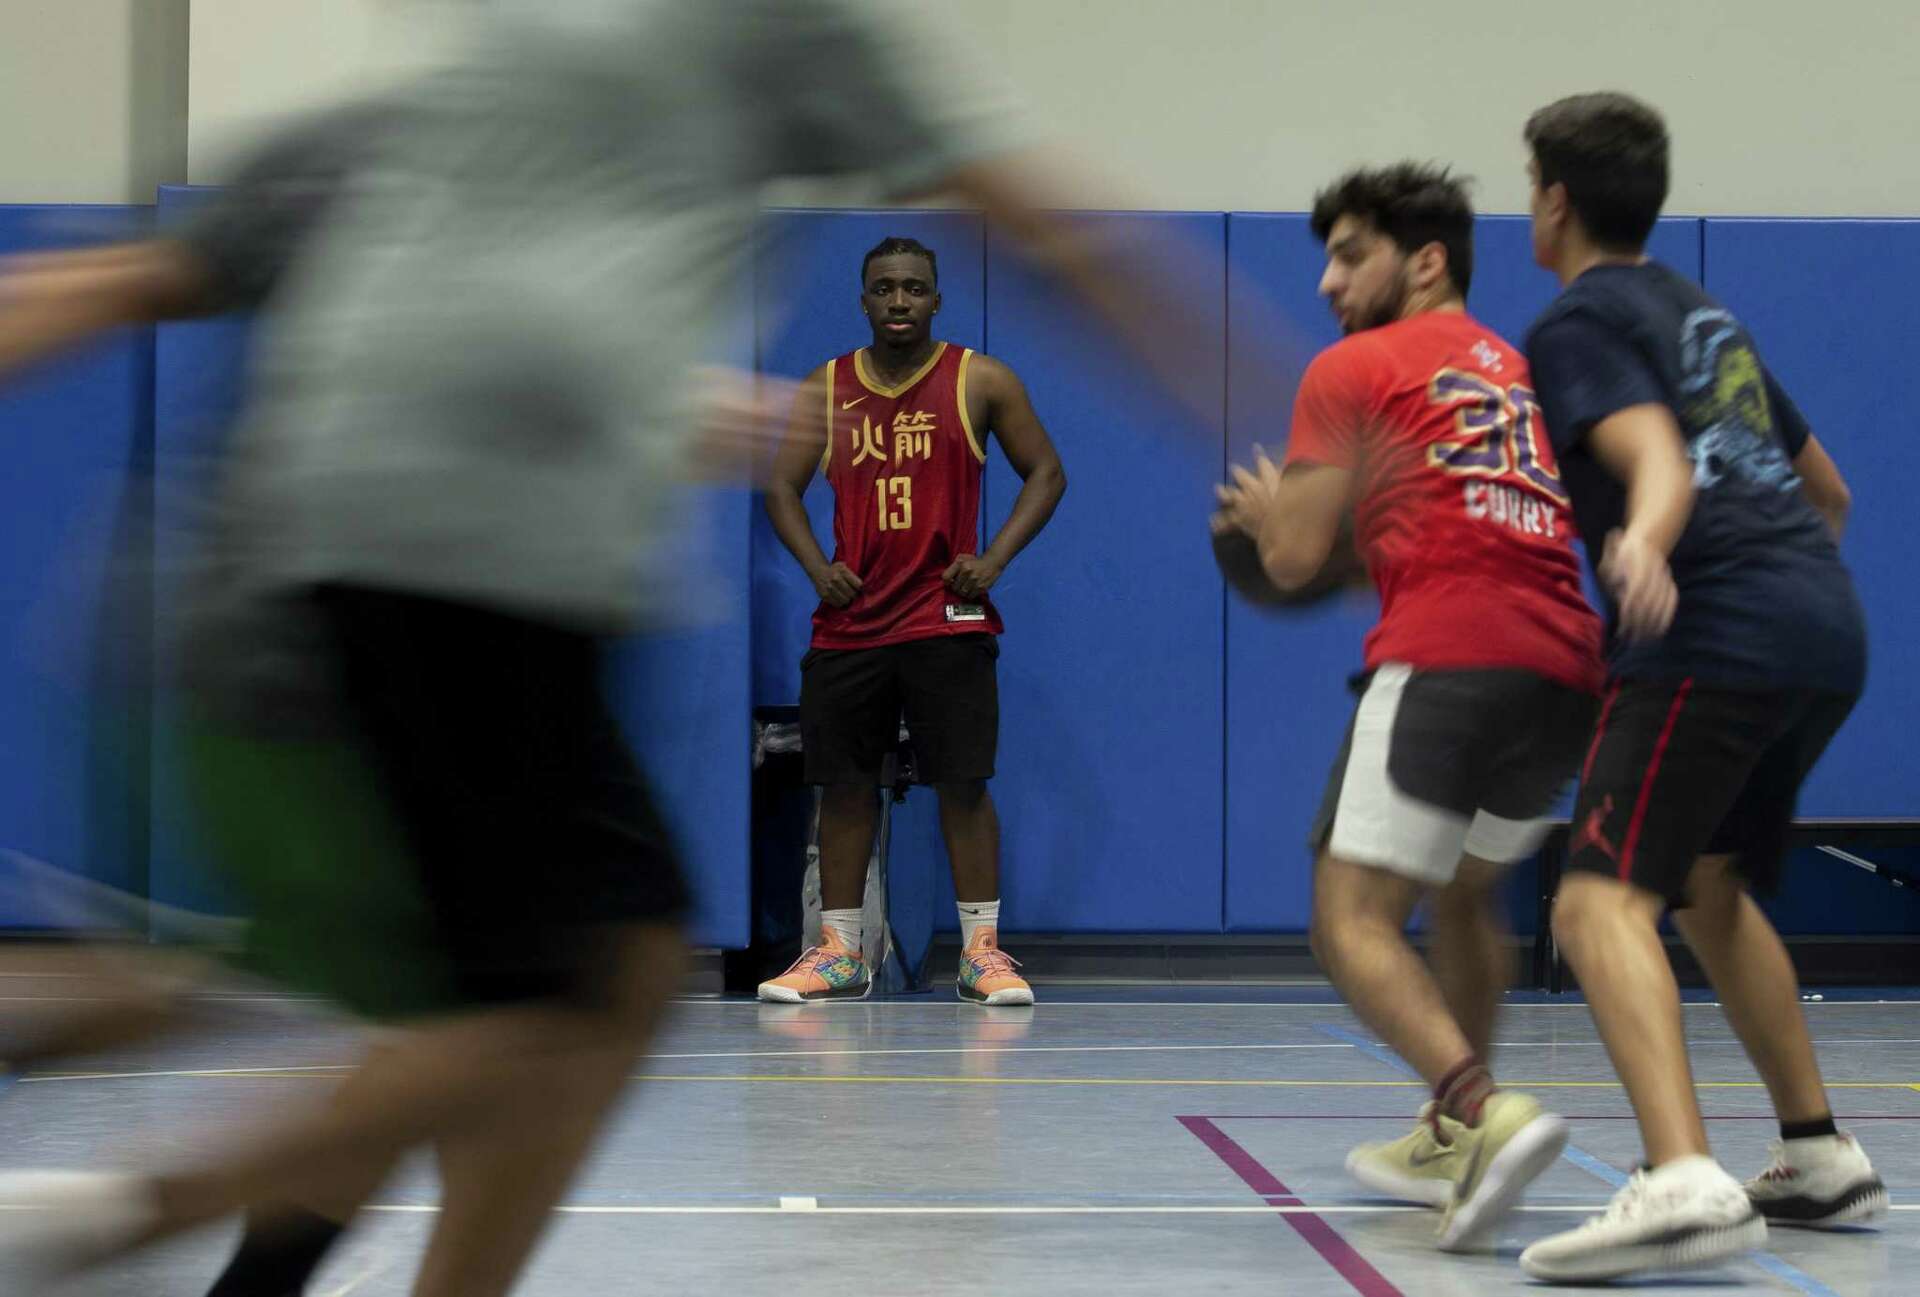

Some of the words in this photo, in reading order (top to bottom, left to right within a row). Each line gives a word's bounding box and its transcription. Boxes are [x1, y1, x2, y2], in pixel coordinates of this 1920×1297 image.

[852, 411, 936, 467] 火箭
[875, 476, 912, 531] 13
[1463, 479, 1556, 538] CURRY
